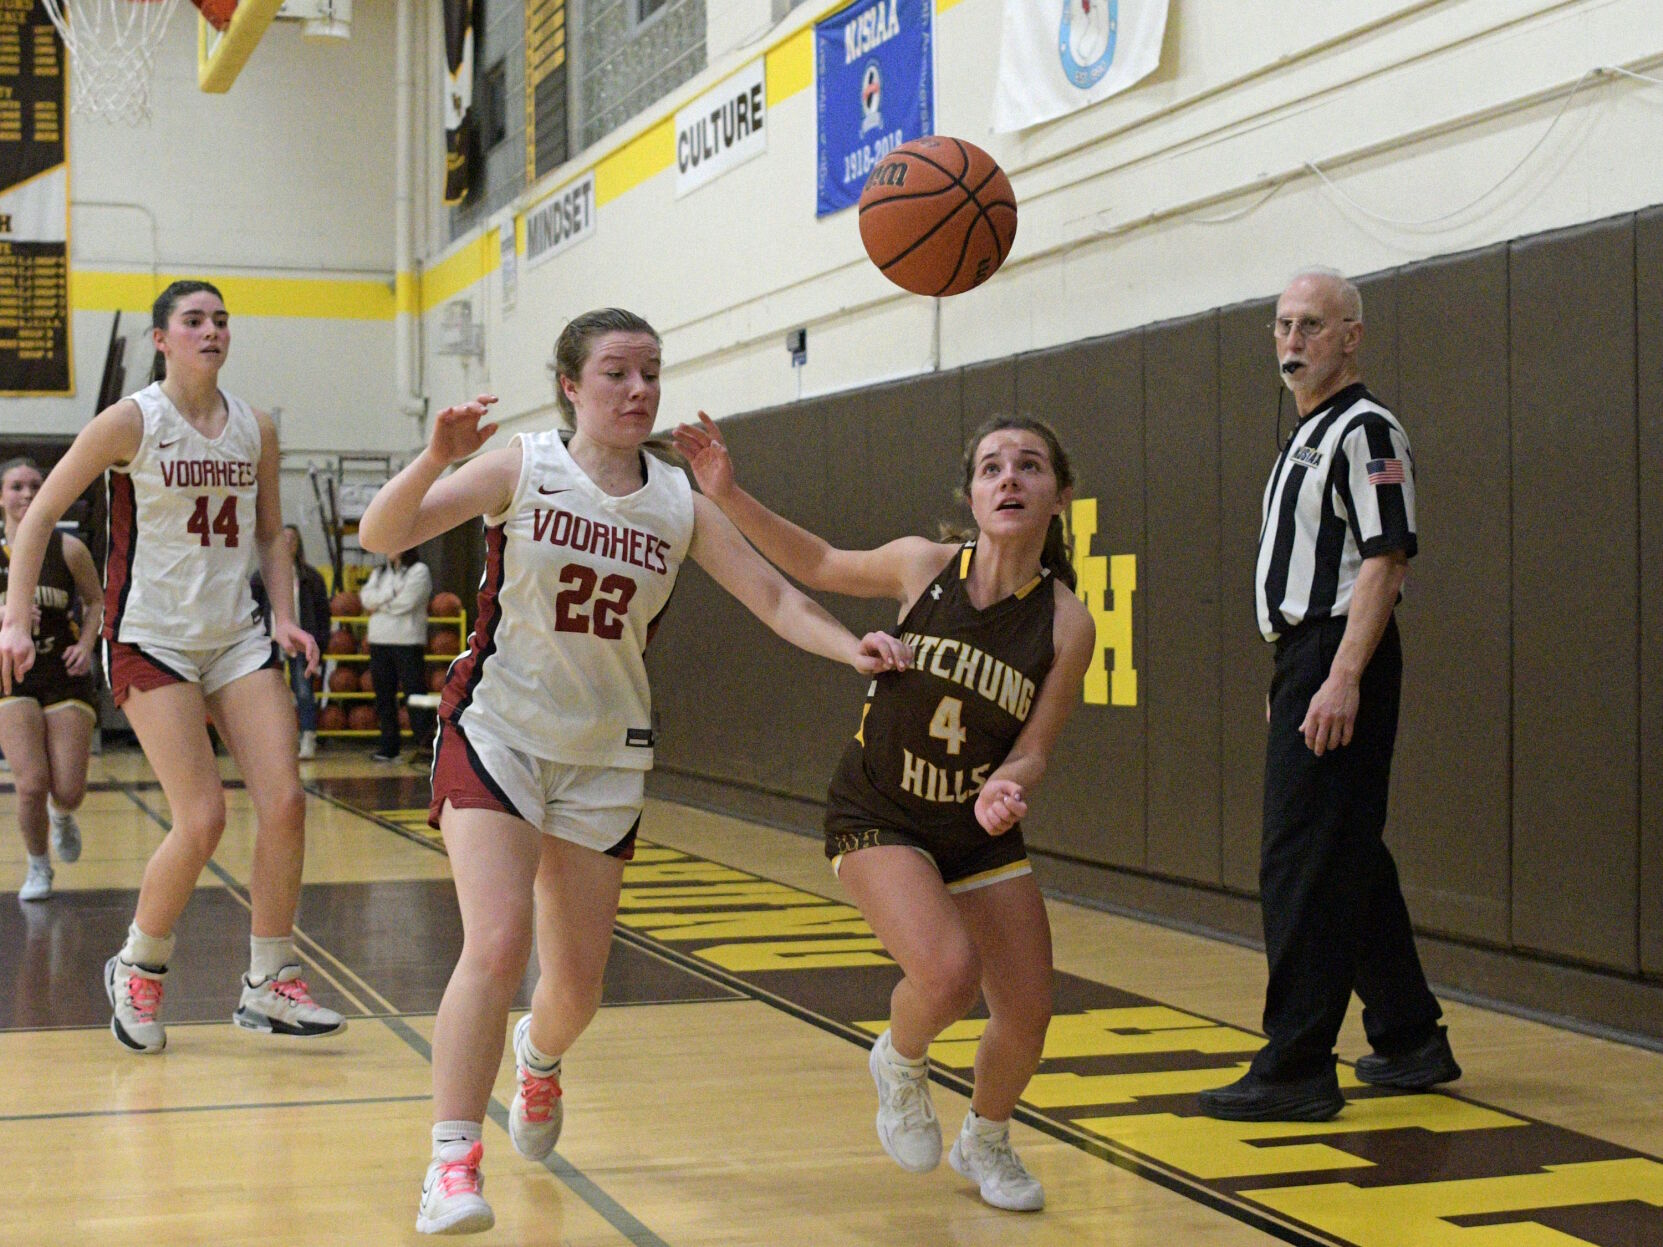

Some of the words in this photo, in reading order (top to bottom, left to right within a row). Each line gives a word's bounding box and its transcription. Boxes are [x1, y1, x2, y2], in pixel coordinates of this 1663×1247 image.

[678, 83, 764, 174] CULTURE
[527, 180, 592, 261] MINDSET
[160, 460, 256, 487] VOORHEES
[187, 495, 240, 548] 44
[533, 508, 671, 576] VOORHEES
[554, 562, 638, 640] 22
[901, 631, 1036, 722] TCHUNG
[928, 695, 968, 755] 4
[900, 748, 991, 804] HILLS
